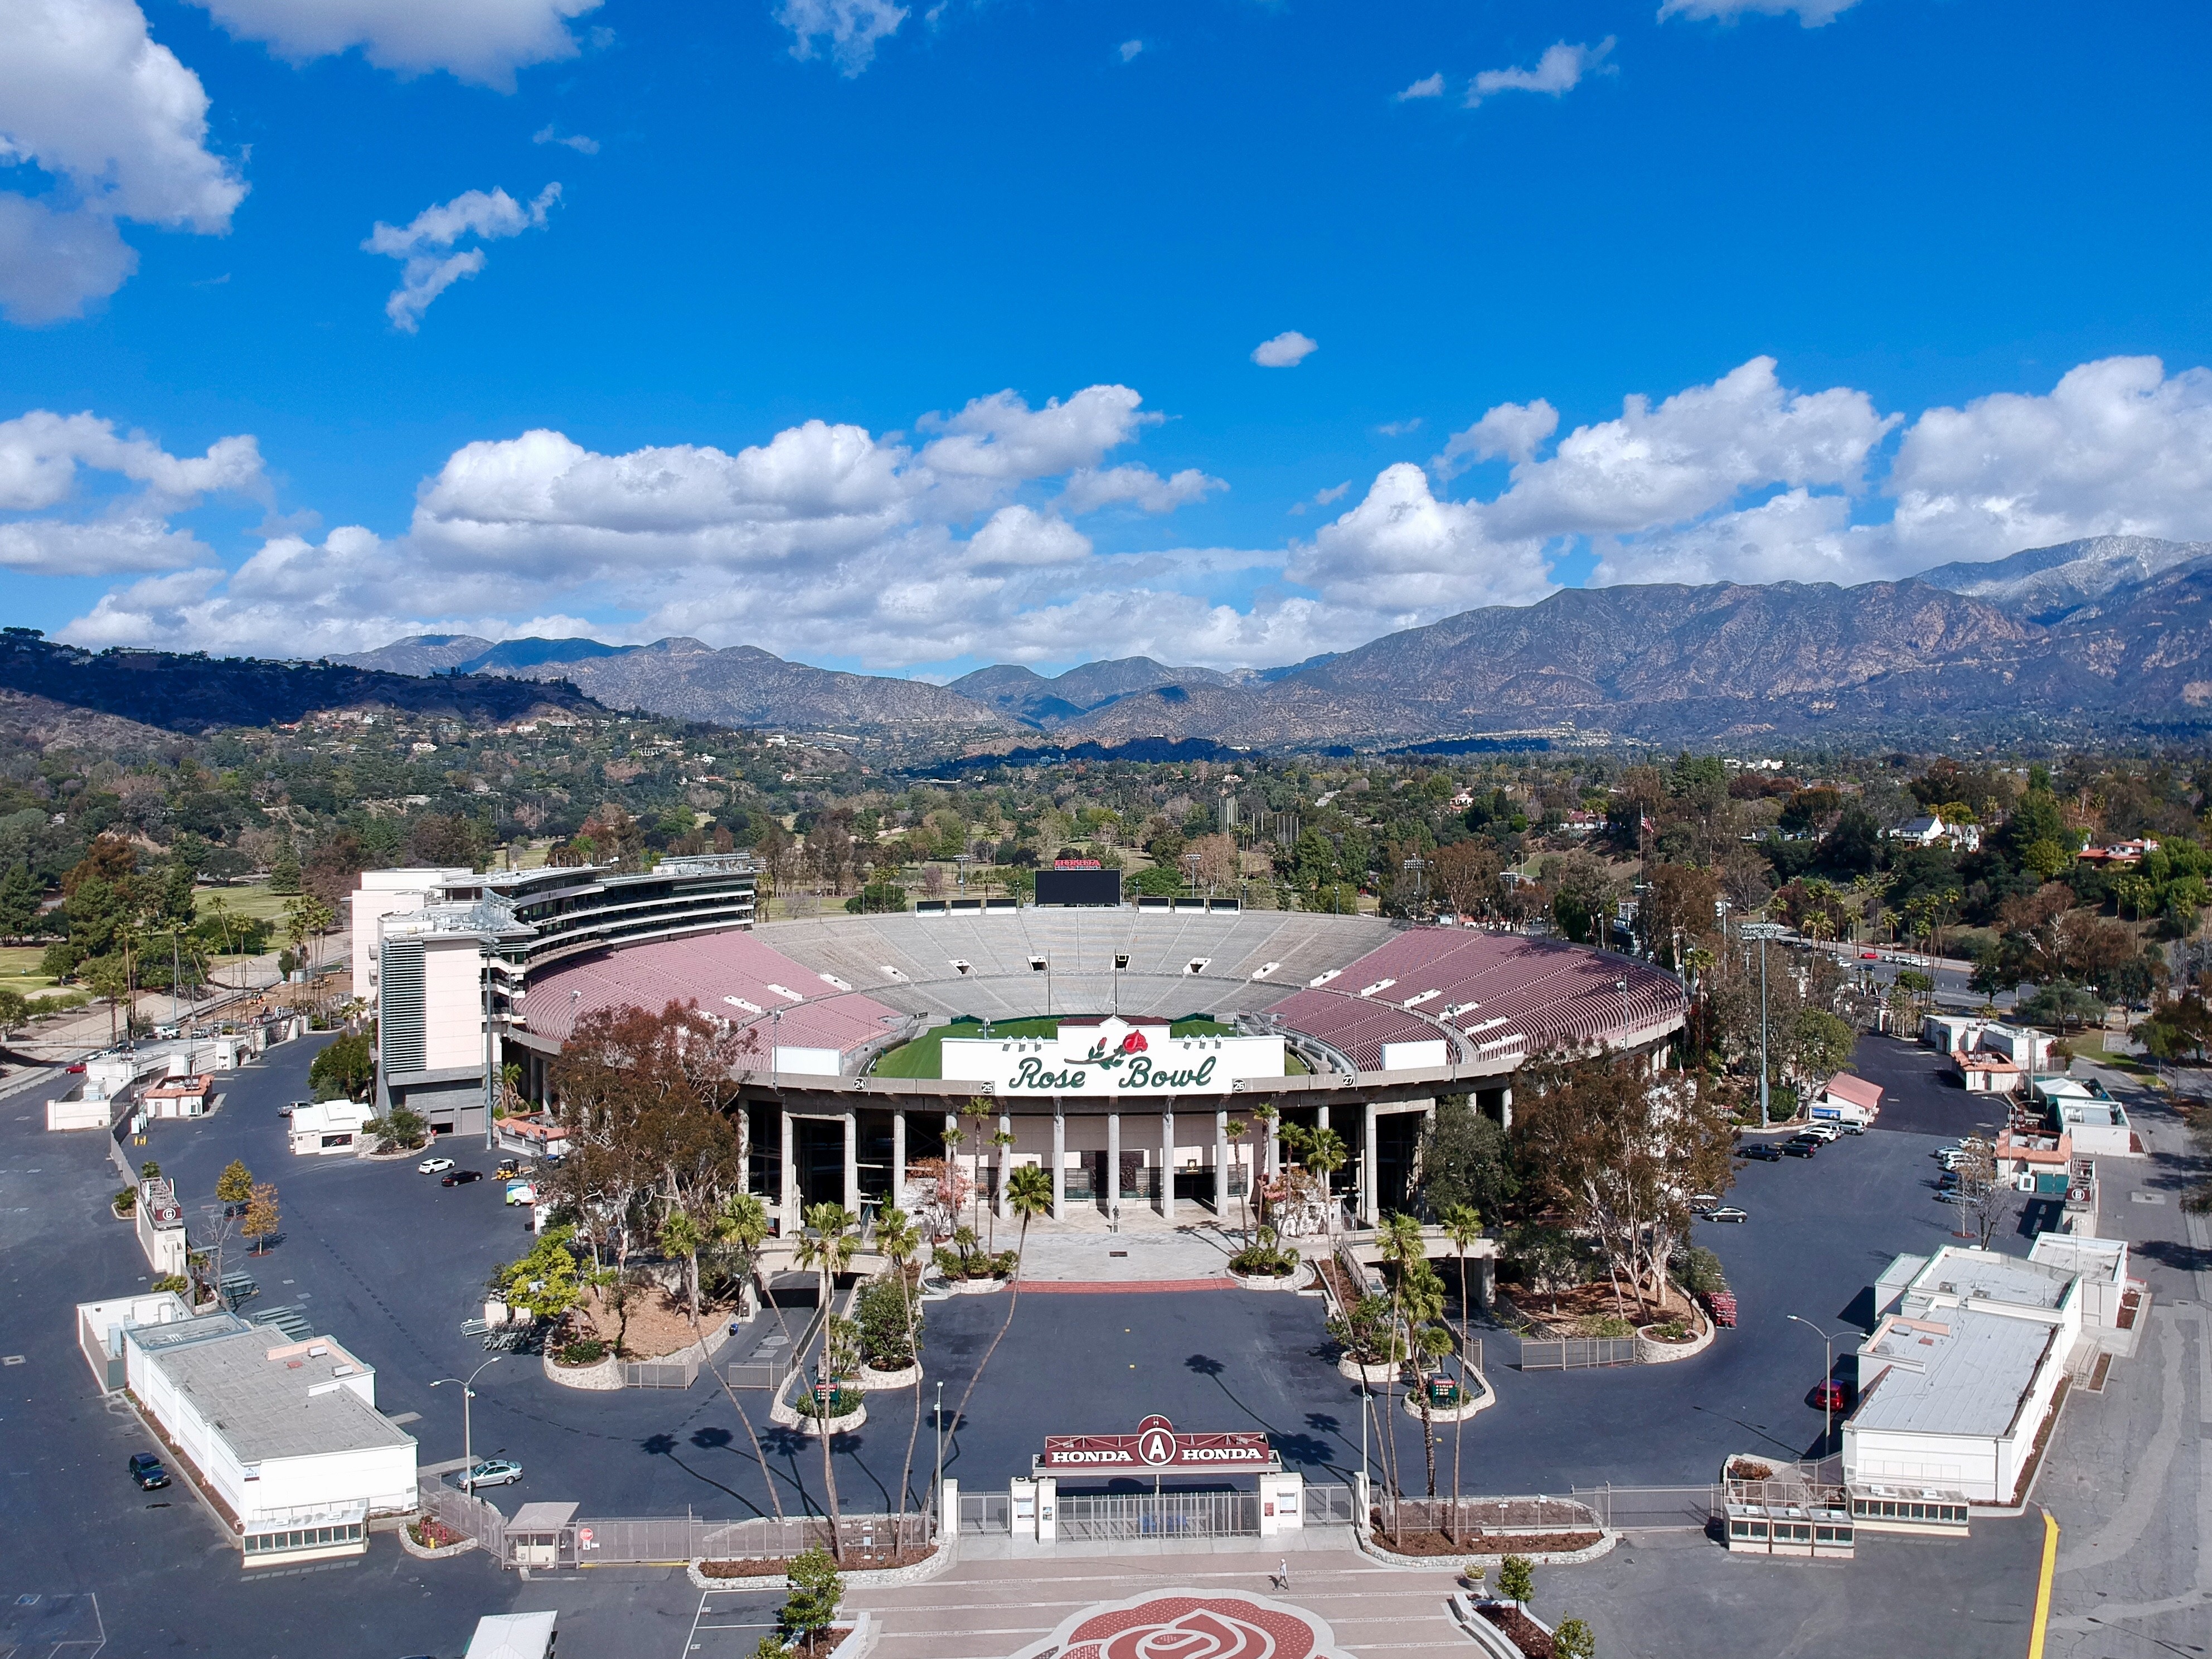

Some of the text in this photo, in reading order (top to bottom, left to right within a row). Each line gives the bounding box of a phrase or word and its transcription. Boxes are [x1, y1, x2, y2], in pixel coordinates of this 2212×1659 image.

[1008, 1056, 1216, 1089] Rose Bowl
[166, 1210, 173, 1218] G
[1149, 1434, 1166, 1459] A
[1051, 1452, 1133, 1463] HONDA
[1181, 1448, 1263, 1461] HONDA
